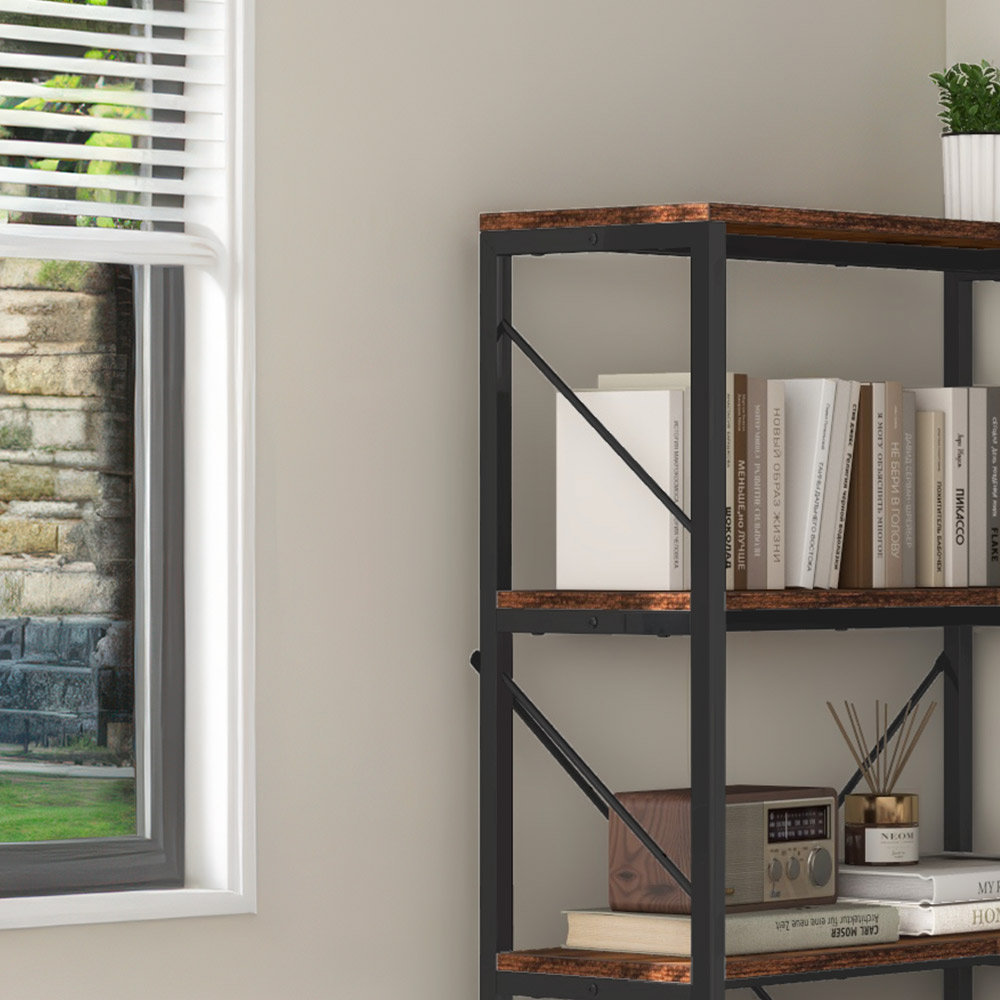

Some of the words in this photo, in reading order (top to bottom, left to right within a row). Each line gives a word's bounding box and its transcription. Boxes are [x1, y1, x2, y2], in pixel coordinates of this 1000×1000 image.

[773, 408, 781, 458] НОВЫЙ
[891, 442, 899, 458] НЕ
[891, 461, 899, 493] БЕРИ
[773, 463, 781, 507] ОБРАЗ
[891, 497, 899, 505] В
[956, 488, 964, 545] ПИКАССО
[773, 512, 781, 563] ЖИЗНИ
[890, 509, 899, 558] ГОЛОВУ
[881, 832, 913, 840] NEOM
[978, 881, 994, 894] MY
[792, 919, 809, 927] neue
[811, 918, 825, 926] eine
[828, 917, 838, 926] für
[840, 914, 879, 925] Architektur
[831, 927, 857, 938] MOSER
[860, 925, 879, 935] CARL
